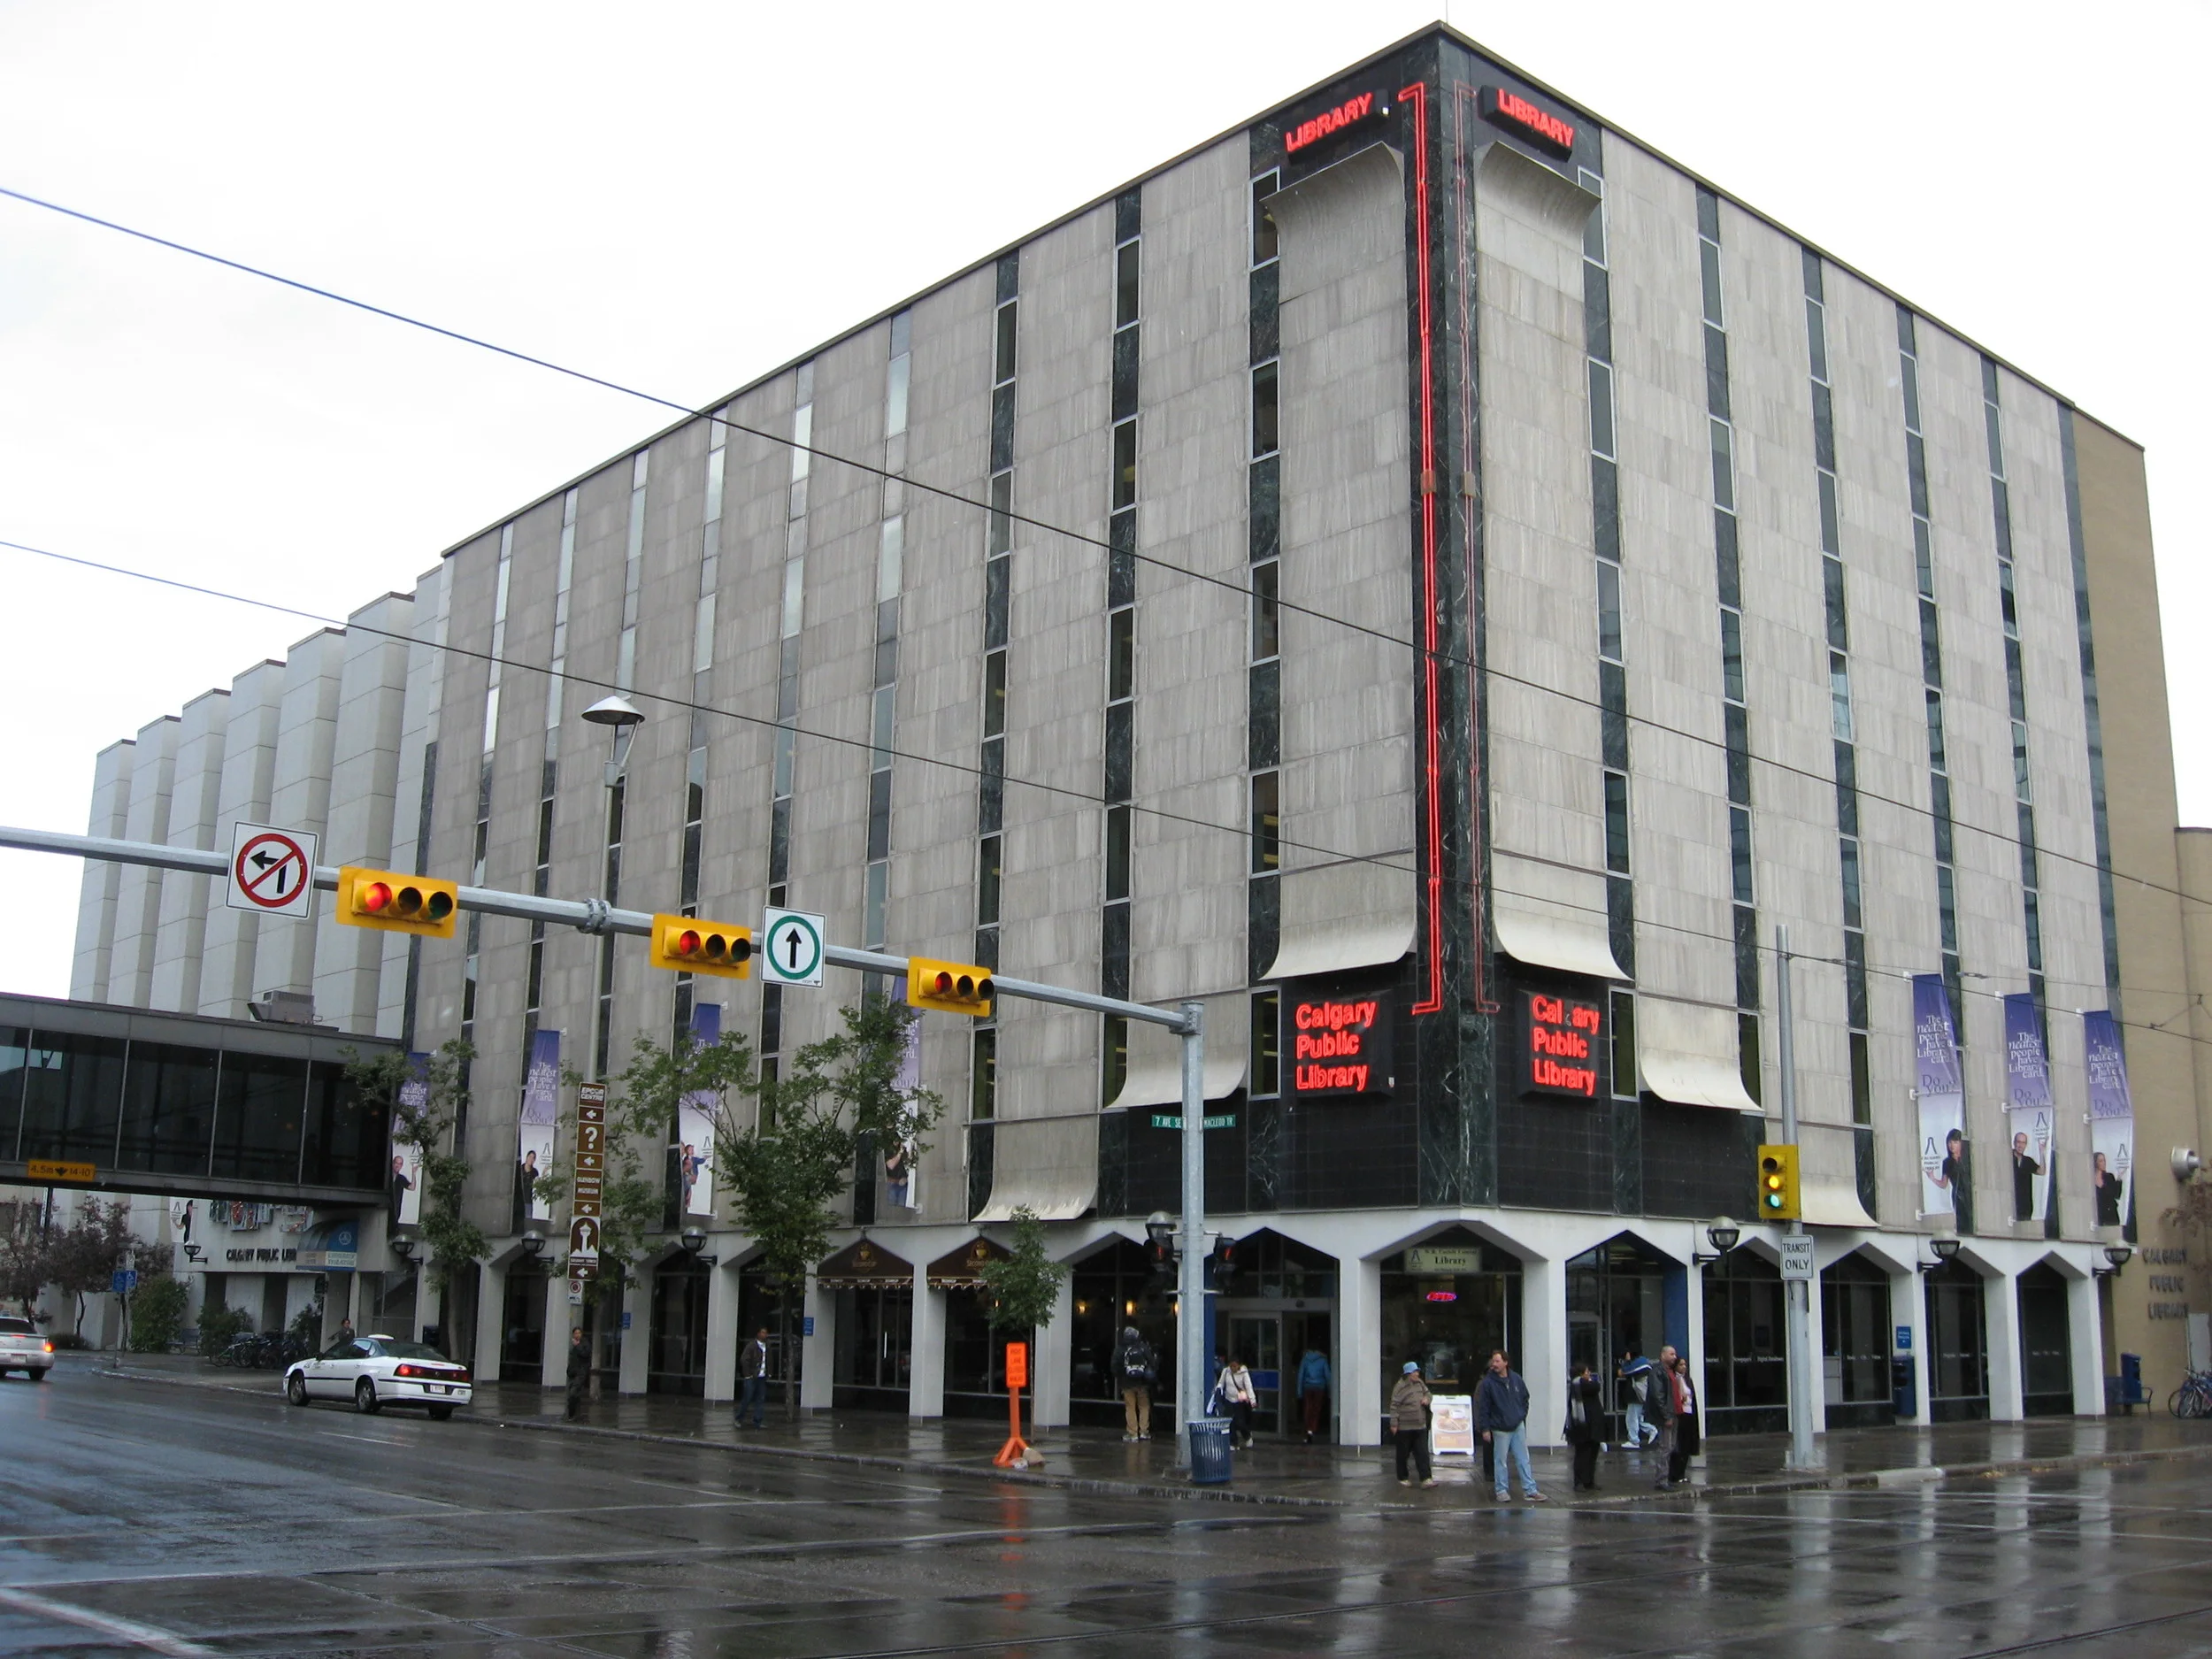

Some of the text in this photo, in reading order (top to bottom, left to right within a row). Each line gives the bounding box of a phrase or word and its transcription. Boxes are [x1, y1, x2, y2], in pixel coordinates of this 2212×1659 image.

[1286, 92, 1372, 152] LIBRARY
[1498, 88, 1574, 148] LIBRARY
[1296, 1002, 1376, 1031] Calgary
[1533, 995, 1600, 1035] Calary
[1926, 1015, 1941, 1024] The
[1533, 1026, 1588, 1058] Public
[2017, 1032, 2035, 1041] The
[1296, 1031, 1359, 1059] Public
[1296, 1064, 1367, 1092] Library
[1533, 1059, 1595, 1096] Library
[1922, 1074, 1940, 1087] Do
[2014, 1088, 2032, 1100] Do
[2093, 1099, 2111, 1110] Do
[1155, 1117, 1182, 1129] 7 AVE SE
[1783, 1243, 1810, 1253] TRANSIT
[2142, 1248, 2188, 1264] CALGARY
[1434, 1256, 1465, 1266] Library
[1785, 1259, 1809, 1270] ONLY
[2149, 1275, 2185, 1293] PUBLIC
[2148, 1303, 2189, 1320] LIBRARY
